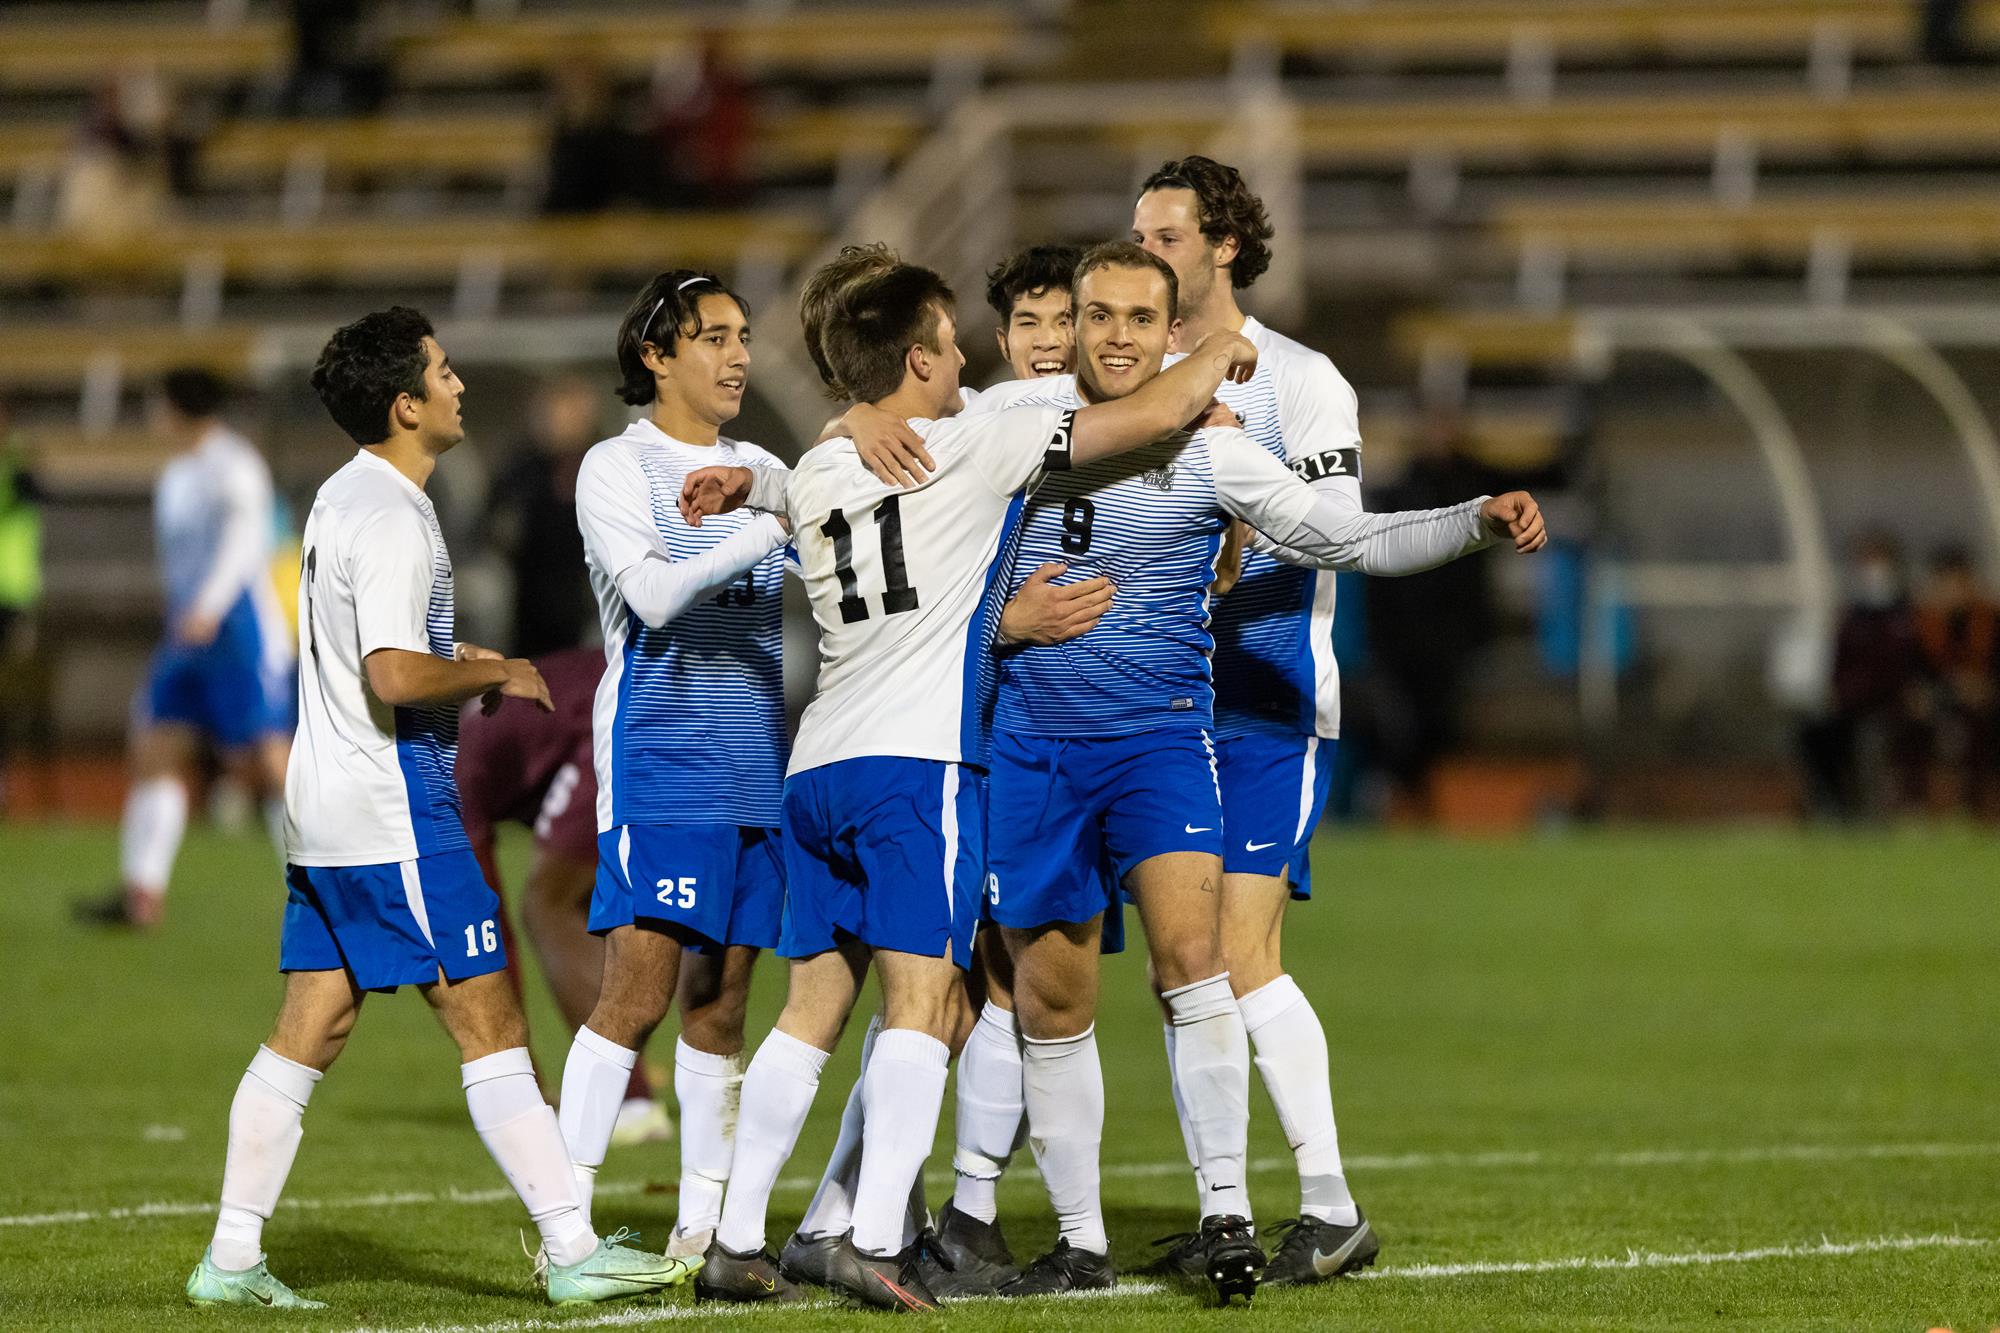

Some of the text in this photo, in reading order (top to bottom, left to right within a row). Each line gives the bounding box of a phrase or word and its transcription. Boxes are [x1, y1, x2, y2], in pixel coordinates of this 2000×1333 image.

[1061, 498, 1095, 556] 9
[820, 494, 919, 624] 11
[657, 877, 696, 908] 25
[989, 872, 999, 905] 9
[465, 919, 497, 957] 16
